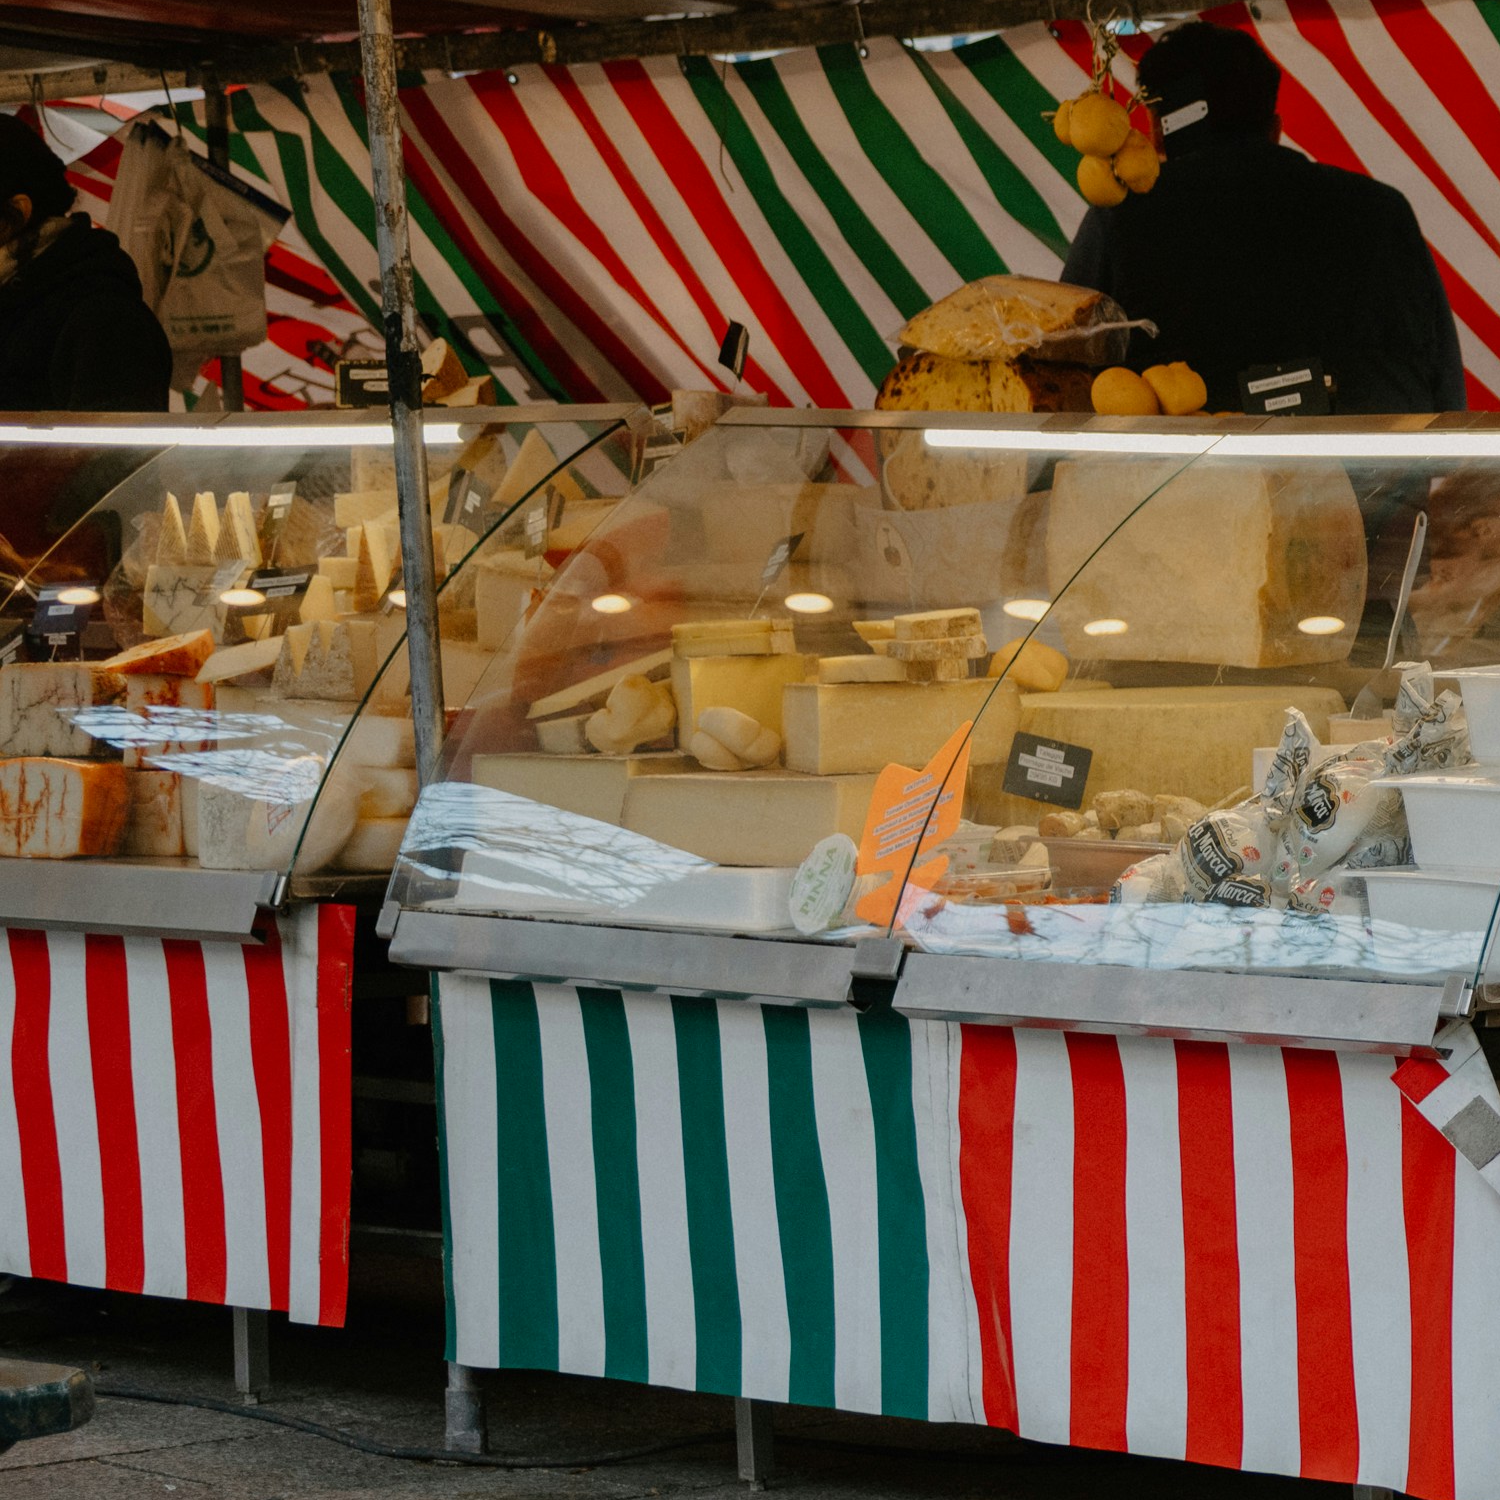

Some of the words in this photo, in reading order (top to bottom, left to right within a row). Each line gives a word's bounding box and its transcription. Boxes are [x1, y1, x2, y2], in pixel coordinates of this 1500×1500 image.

[1198, 831, 1235, 878] Marca
[800, 846, 838, 916] PINNA
[1214, 879, 1264, 908] Marca
